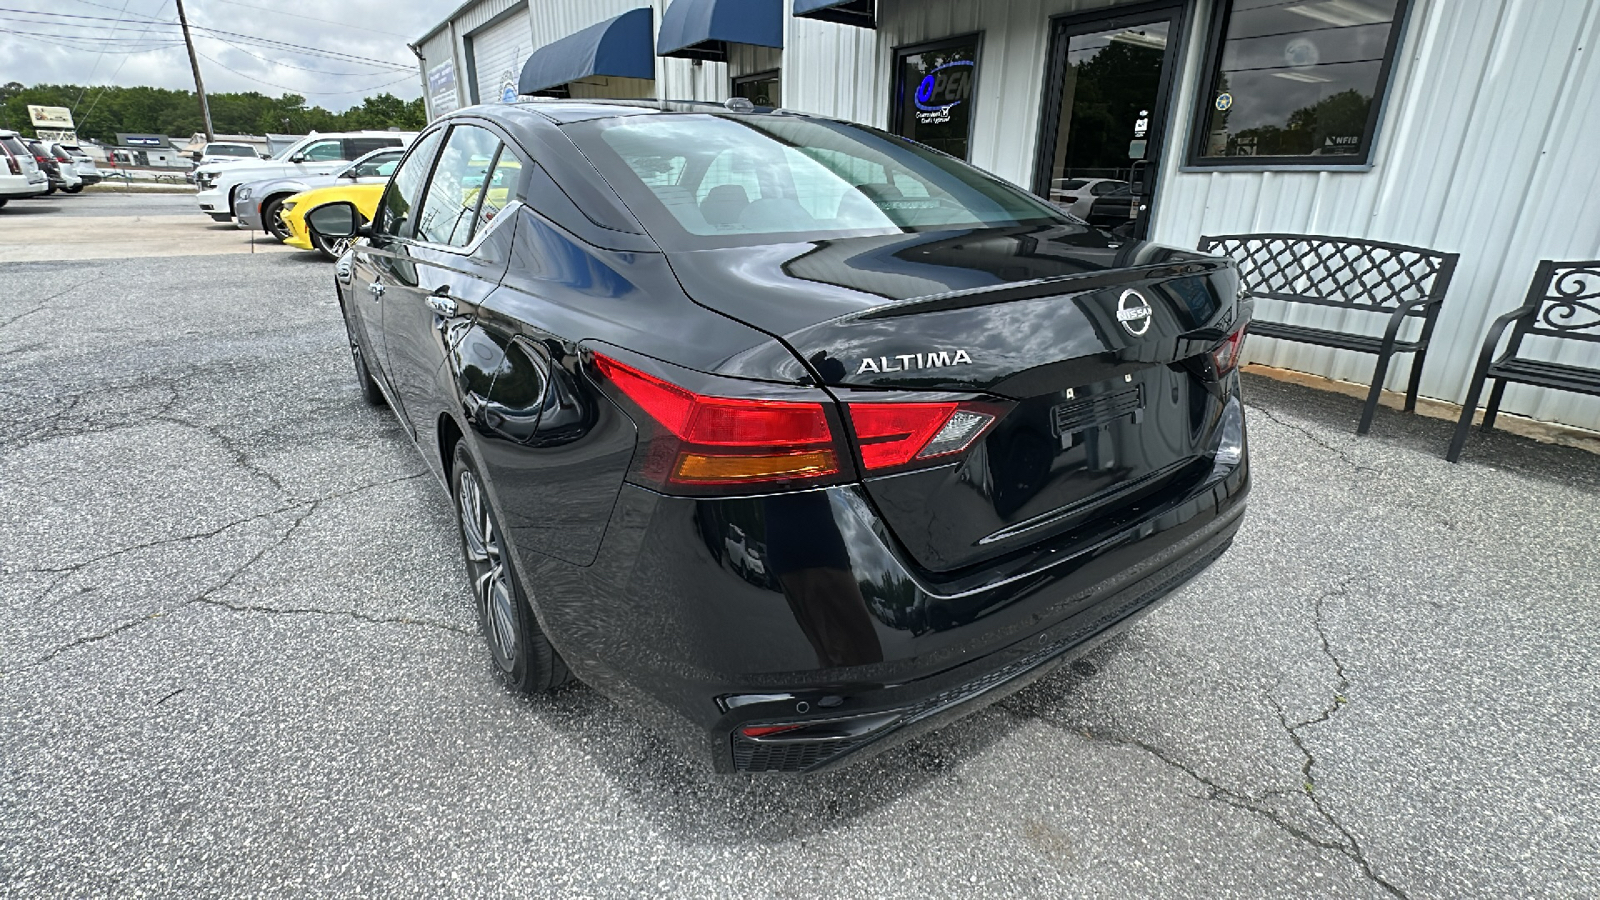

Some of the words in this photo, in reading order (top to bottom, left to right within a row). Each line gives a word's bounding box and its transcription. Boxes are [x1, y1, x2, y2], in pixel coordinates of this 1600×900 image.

[918, 71, 971, 102] OPEN
[1336, 136, 1358, 144] NFIB
[1117, 305, 1152, 321] NISSAN
[856, 350, 972, 375] ALTIMA
